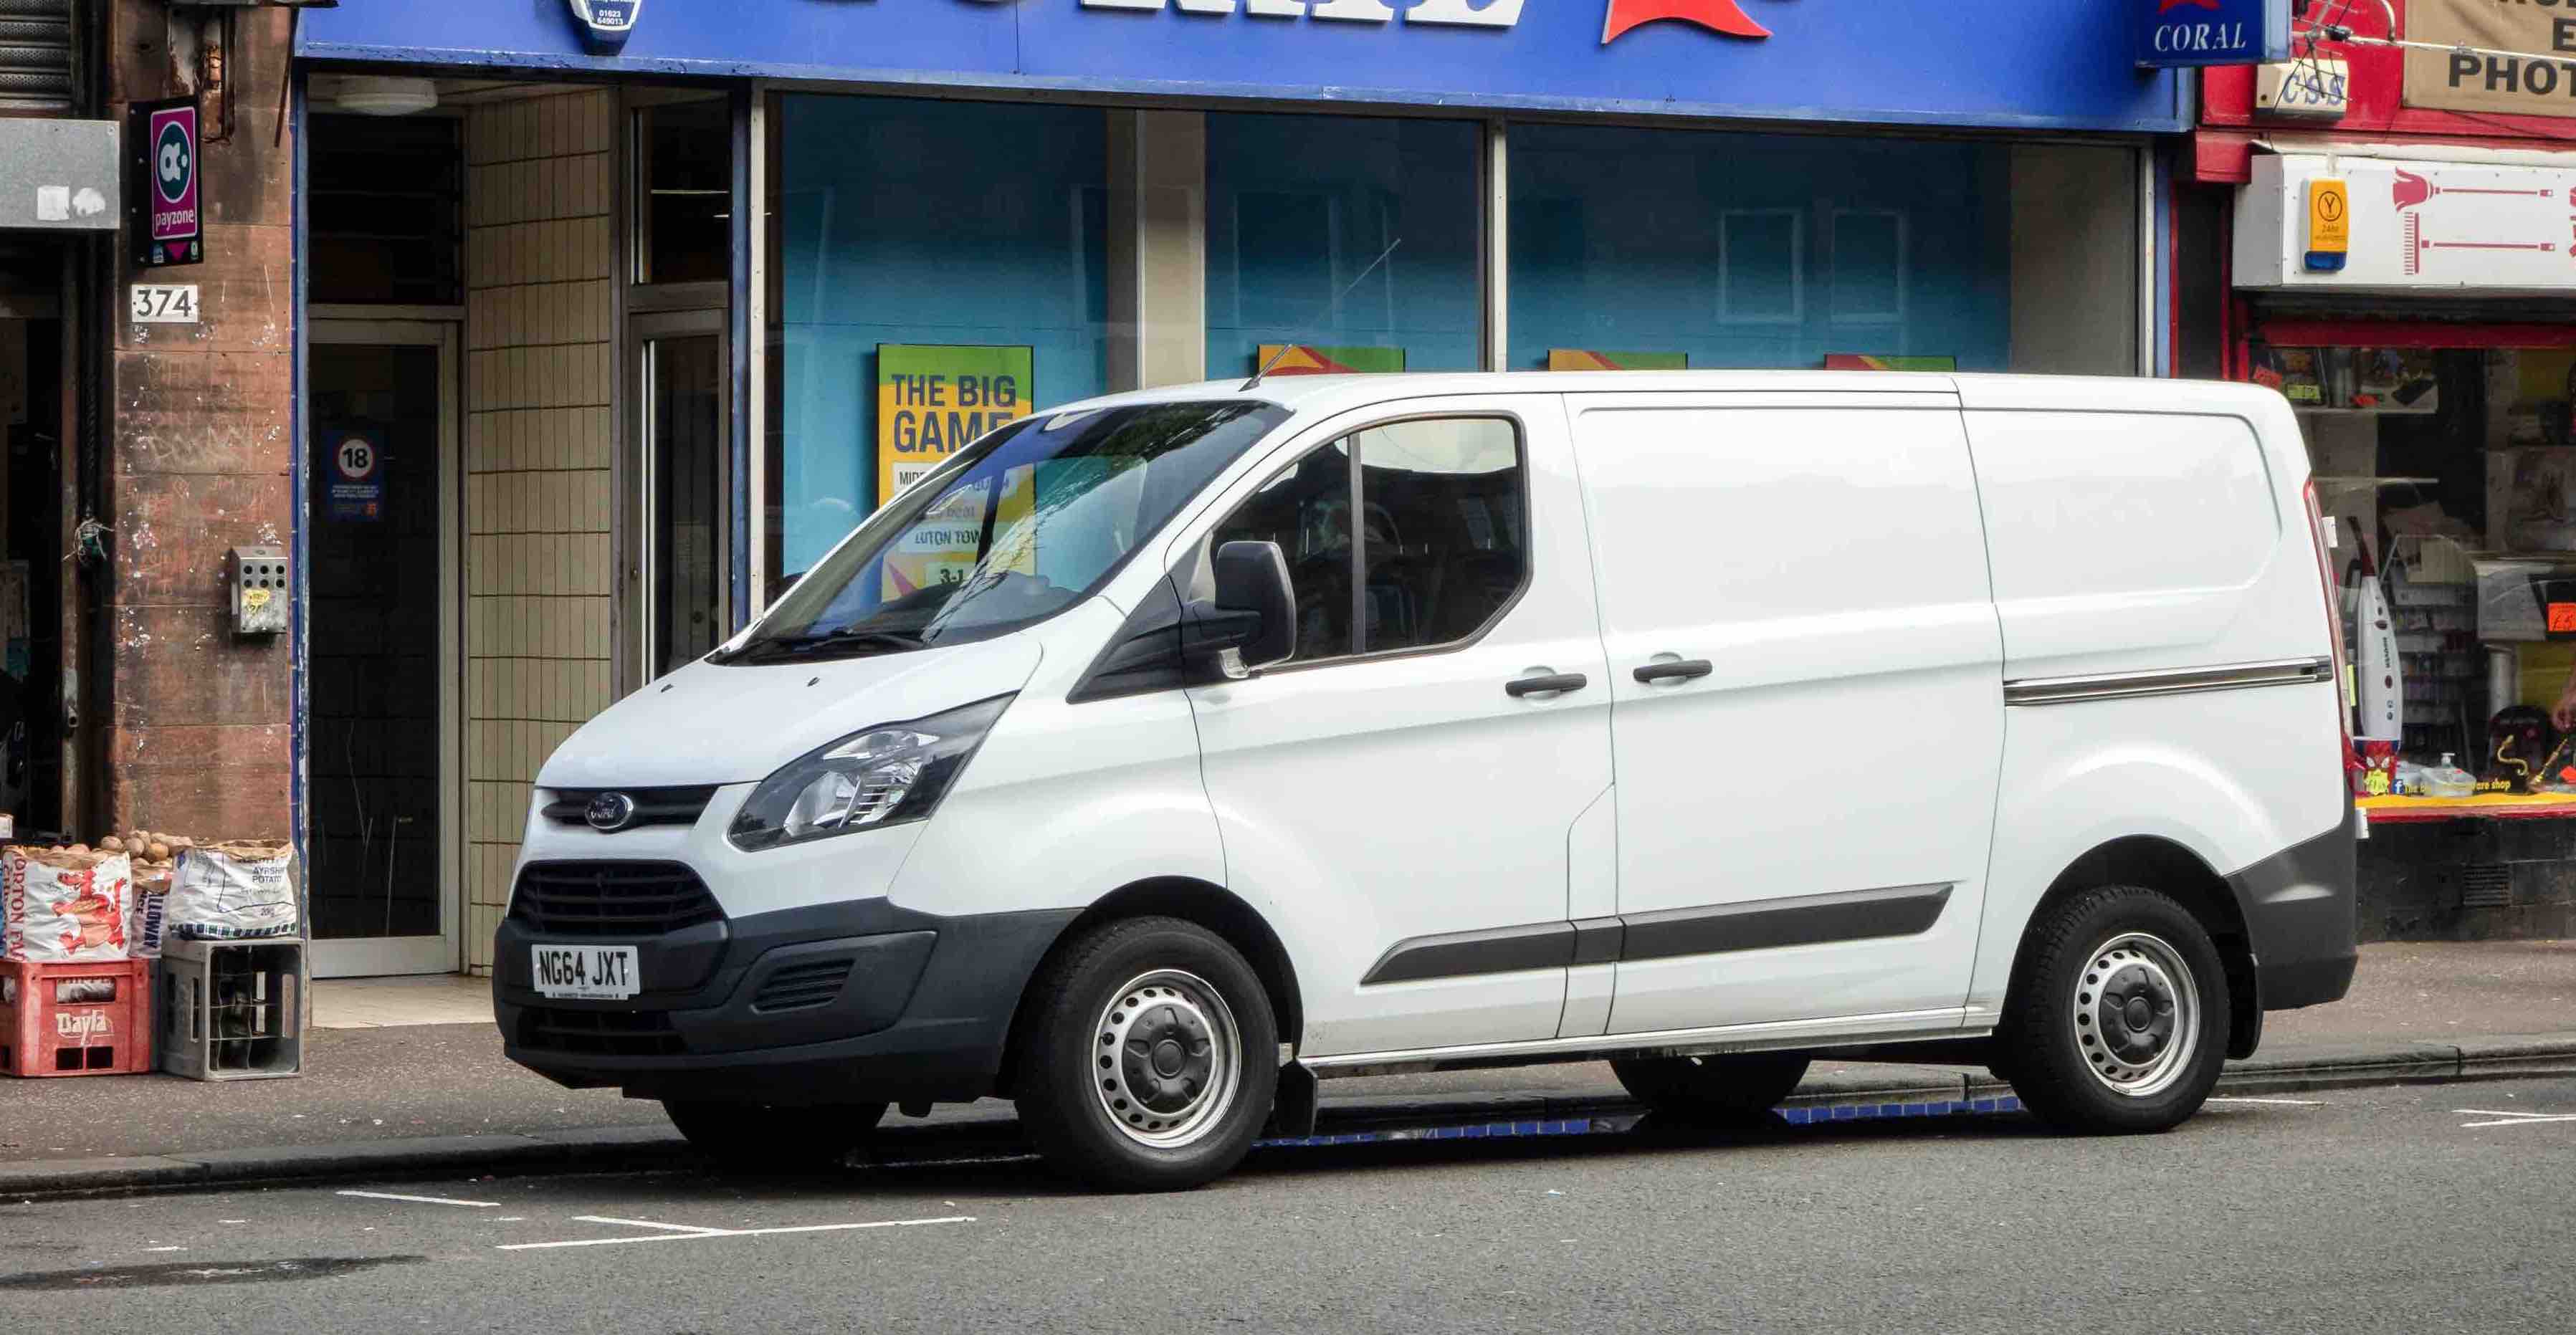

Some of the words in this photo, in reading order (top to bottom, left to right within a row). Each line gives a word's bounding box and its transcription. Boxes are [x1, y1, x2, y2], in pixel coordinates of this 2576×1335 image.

[2155, 23, 2247, 52] CORAL
[153, 209, 195, 233] payzone
[136, 289, 192, 318] 374
[891, 373, 946, 407] THE
[958, 374, 1016, 408] BIG
[343, 447, 368, 469] 18
[914, 530, 951, 545] LUTON
[955, 529, 993, 545] TOW
[940, 568, 964, 585] 3-1
[2491, 777, 2511, 791] shop
[11, 854, 27, 924] ORTON
[143, 894, 164, 949] LLOWAY
[539, 950, 586, 985] NG64
[592, 951, 628, 986] JXT
